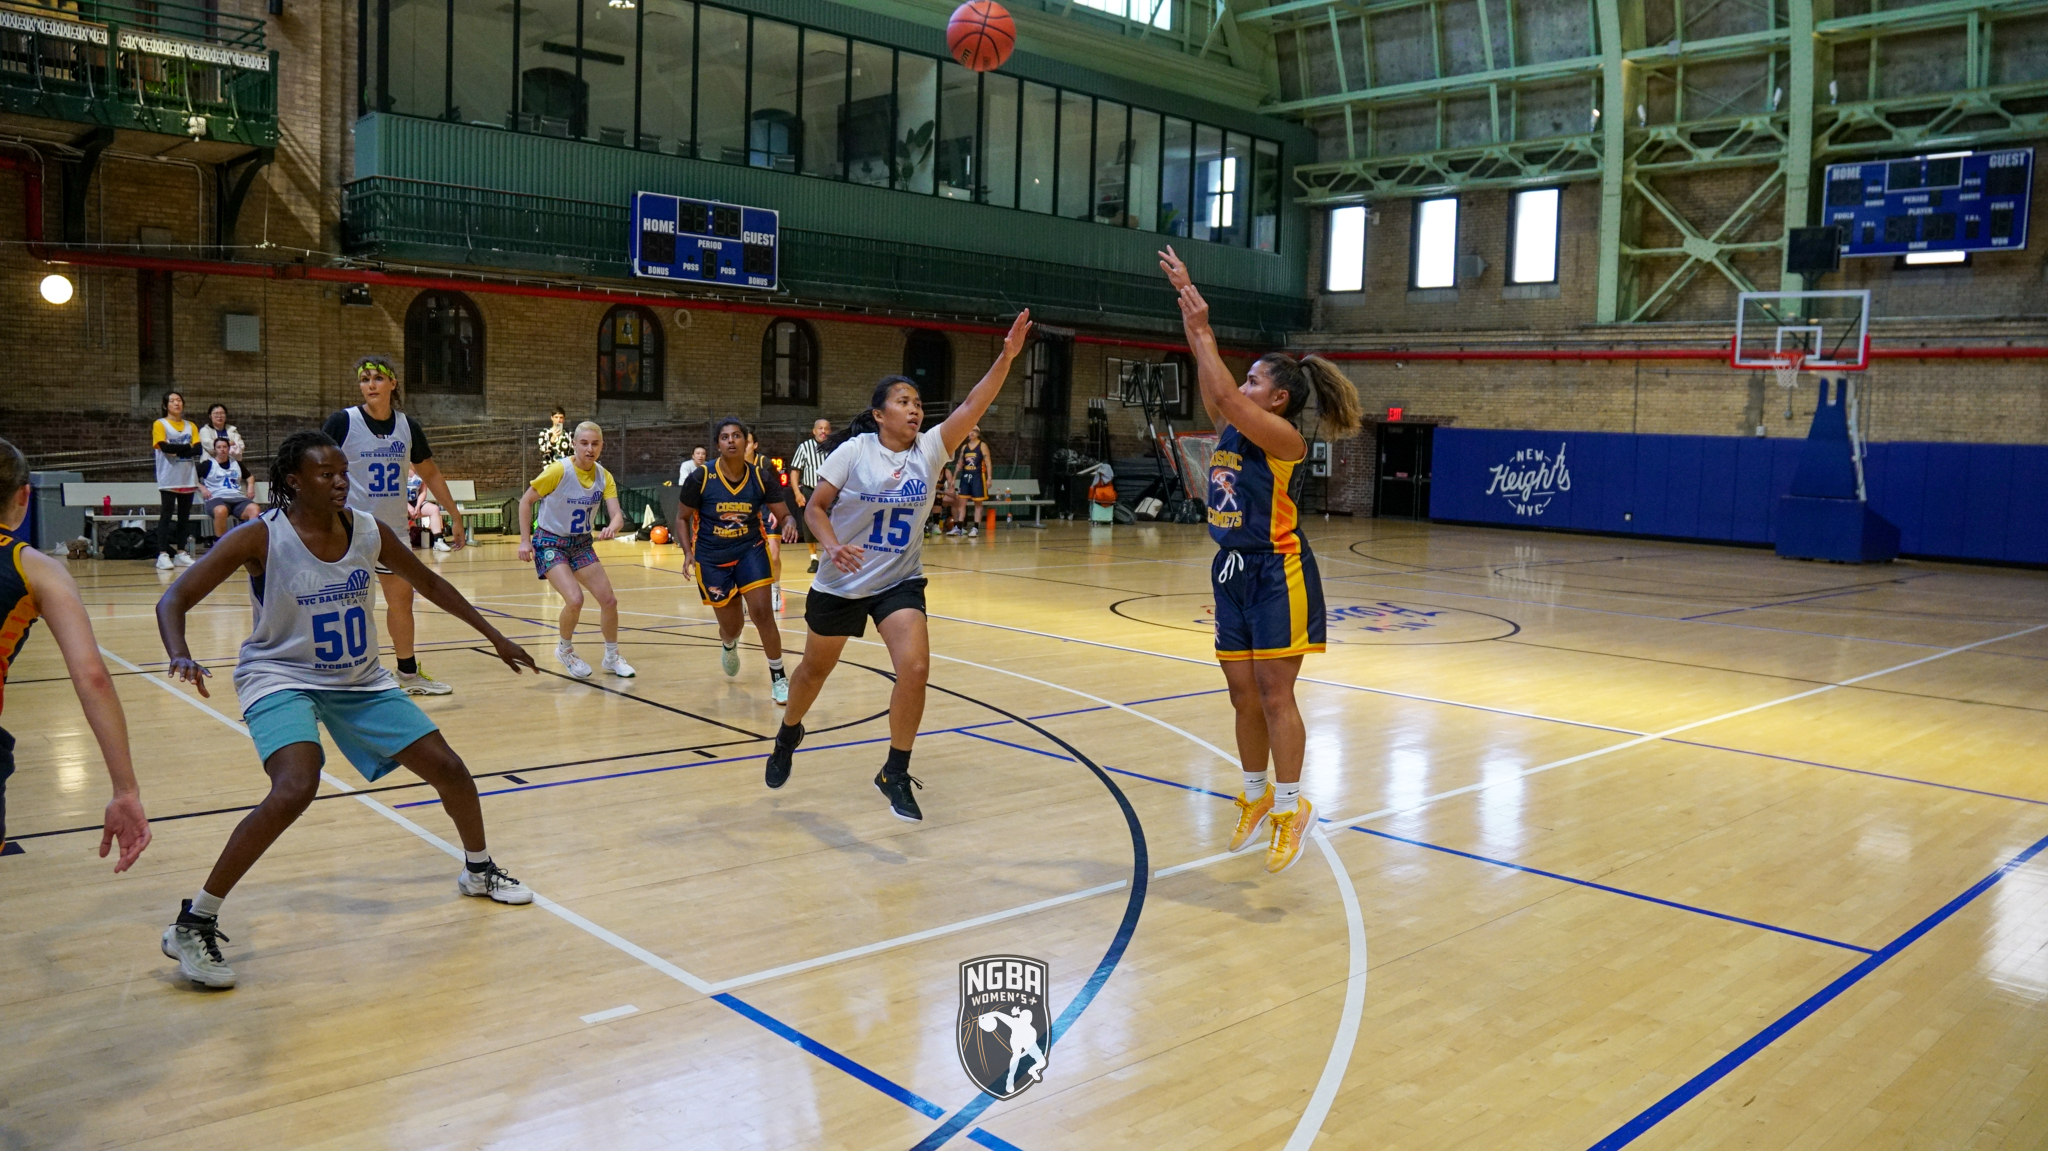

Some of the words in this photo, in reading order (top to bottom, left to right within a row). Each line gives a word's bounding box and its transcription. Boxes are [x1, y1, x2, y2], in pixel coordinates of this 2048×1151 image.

[1988, 152, 2027, 168] GUEST
[1832, 166, 1861, 181] HOME
[1903, 194, 1930, 204] PERIOD
[1907, 206, 1934, 216] PLAYER
[643, 217, 675, 235] HOME
[698, 239, 722, 250] PERIOD
[743, 230, 775, 247] GUEST
[1908, 241, 1928, 250] GAME
[683, 262, 699, 271] POSS
[720, 267, 736, 275] POSS
[648, 266, 669, 276] BONUS
[748, 277, 768, 286] BONUS
[1516, 448, 1544, 462] NEW
[368, 462, 401, 492] 32
[1486, 442, 1571, 502] Heights
[860, 495, 876, 503] NYC
[877, 494, 927, 504] BASKETBALL
[716, 501, 753, 513] COSMIC
[1516, 503, 1544, 517] NYC
[1207, 506, 1243, 528] COMETS
[868, 507, 915, 547] 15
[297, 597, 316, 606] NYC
[311, 605, 368, 662] 50
